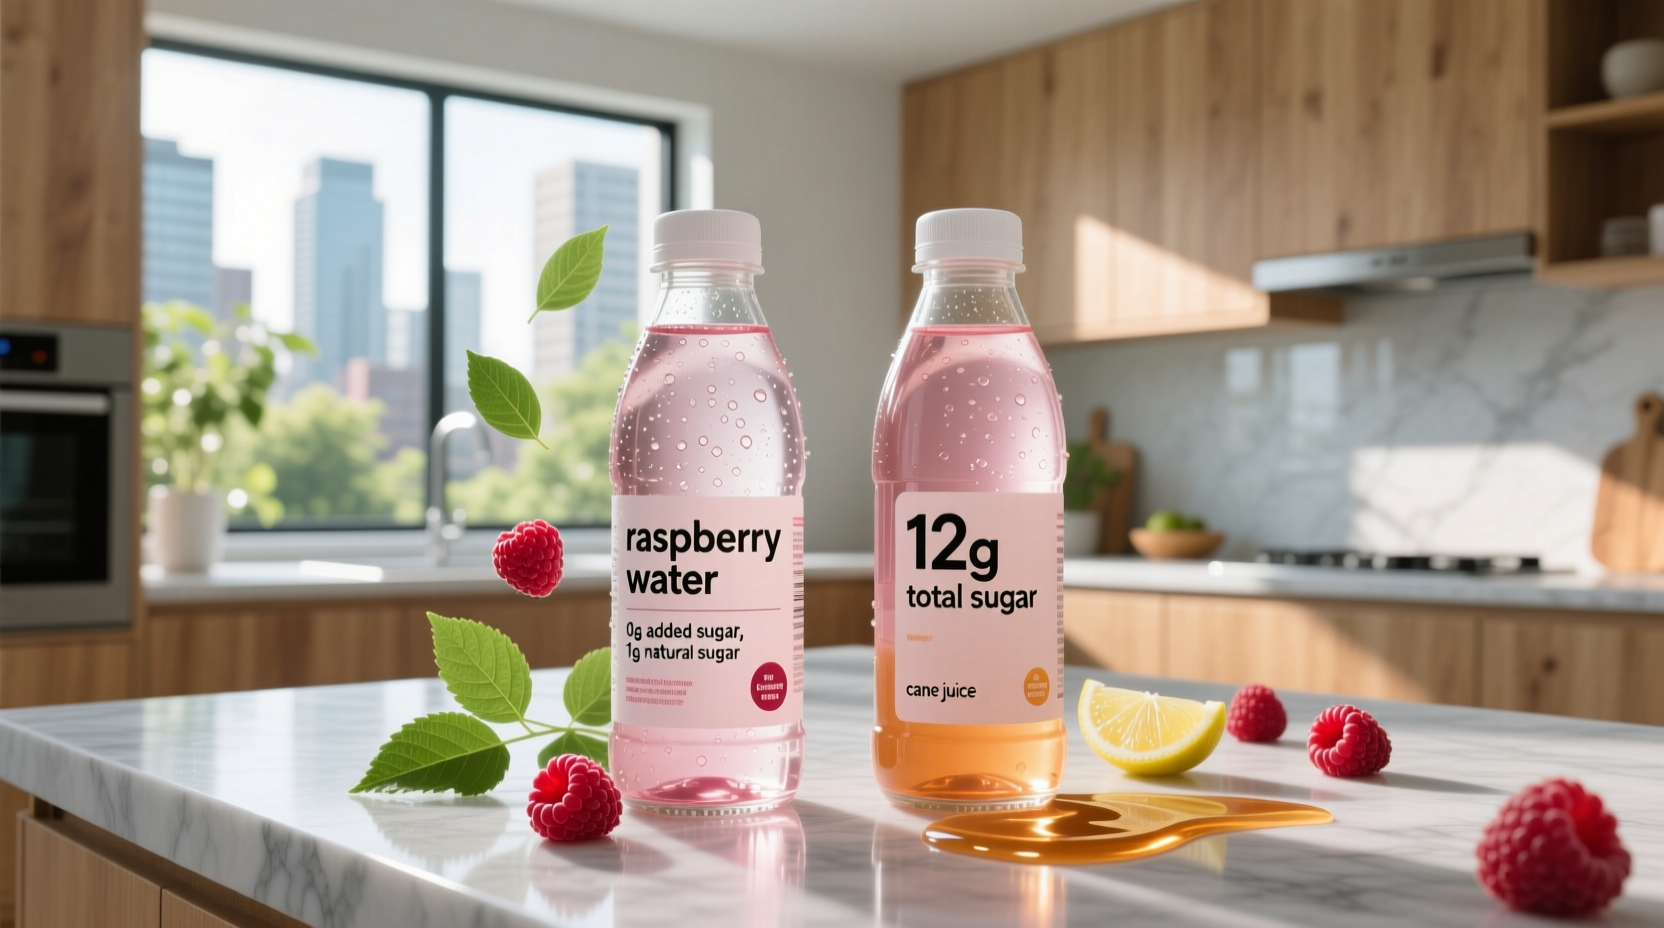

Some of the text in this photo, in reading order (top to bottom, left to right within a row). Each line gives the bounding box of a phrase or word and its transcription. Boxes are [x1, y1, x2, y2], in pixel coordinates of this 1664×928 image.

[626, 519, 782, 562] raspberry
[906, 512, 999, 582] 12g
[626, 565, 719, 595] water
[906, 583, 1038, 615] total sugar
[626, 621, 744, 642] 0g added sugar,
[625, 642, 741, 664] 1g natural sugar
[906, 682, 977, 703] cane juice
